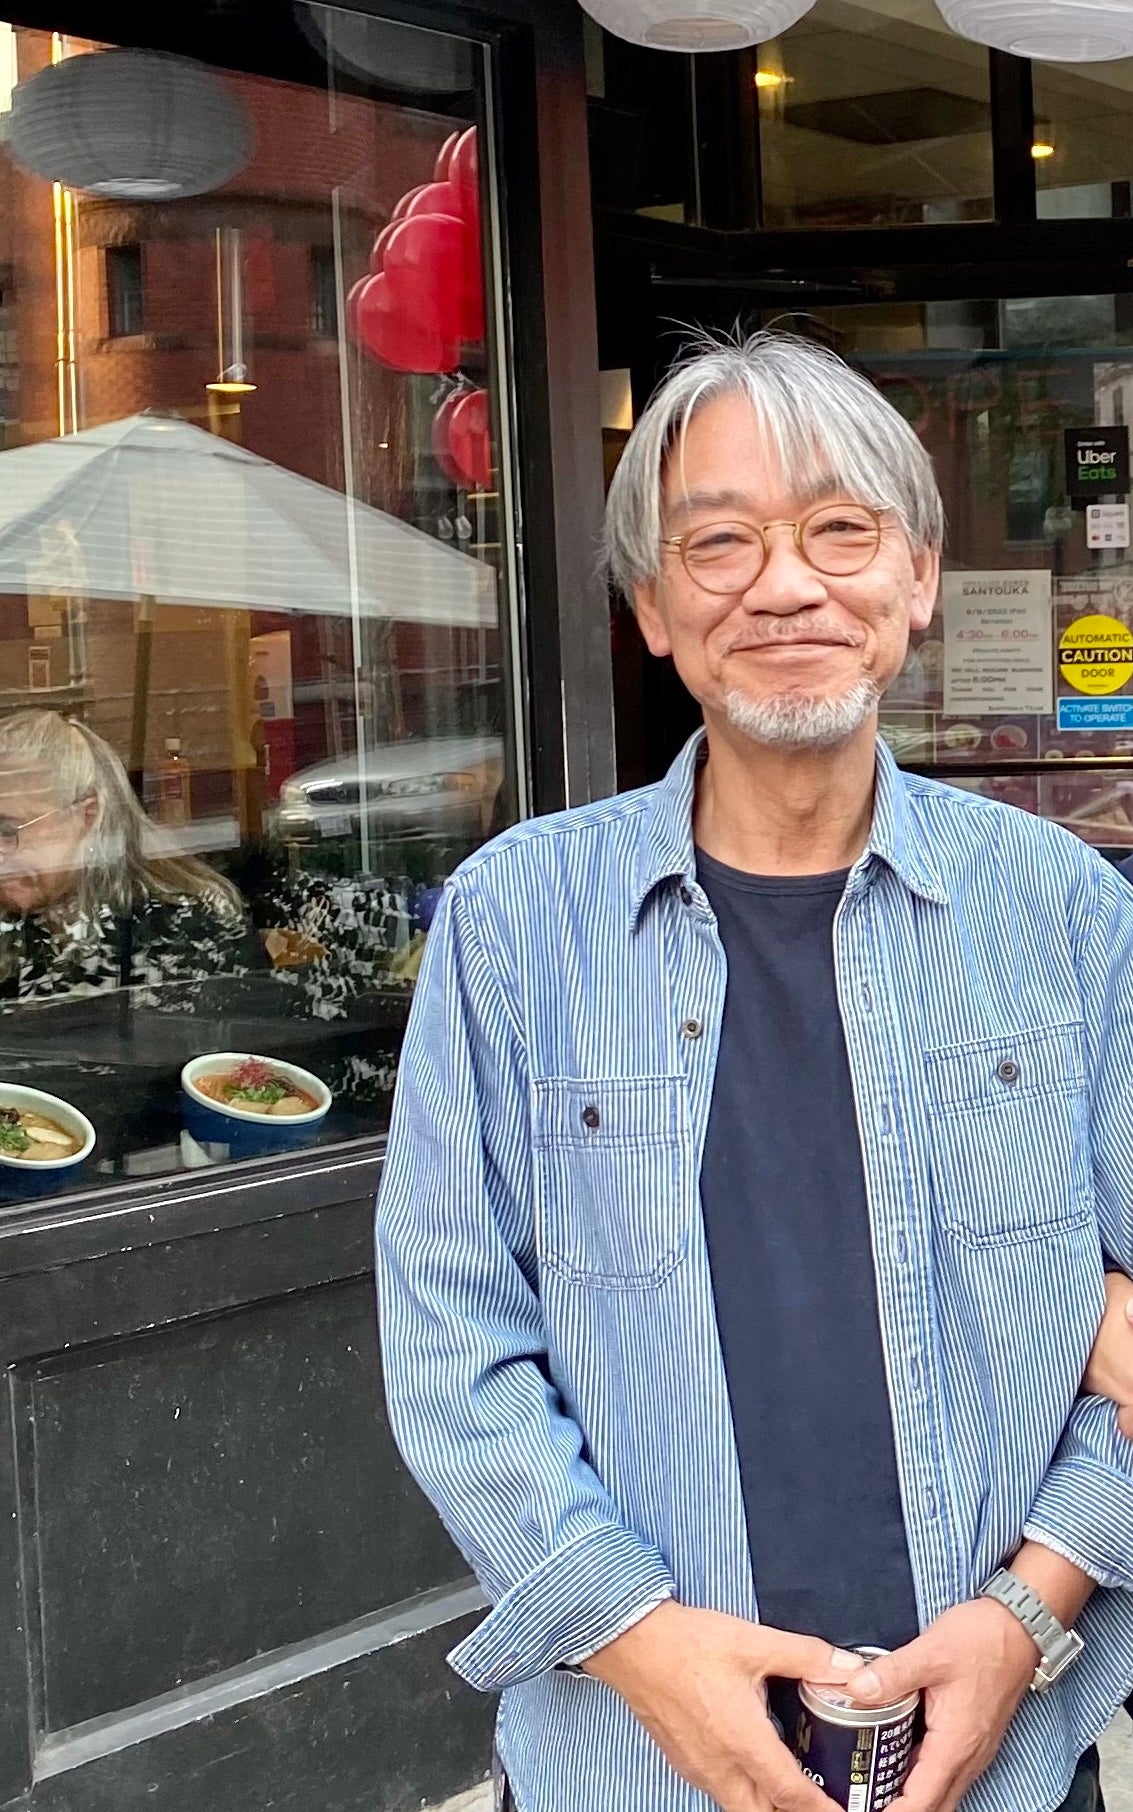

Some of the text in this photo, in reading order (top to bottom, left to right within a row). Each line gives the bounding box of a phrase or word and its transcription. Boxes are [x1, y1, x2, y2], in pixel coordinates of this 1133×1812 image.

[1077, 449, 1117, 464] Uber
[1077, 466, 1117, 480] Eats
[962, 586, 1030, 596] SANTOUKA
[1063, 633, 1131, 644] AUTOMATIC
[1061, 648, 1133, 662] CAUTION
[1082, 668, 1116, 679] DOOR
[1060, 704, 1099, 713] ACTIVATE
[1069, 713, 1126, 723] TO OPERATE
